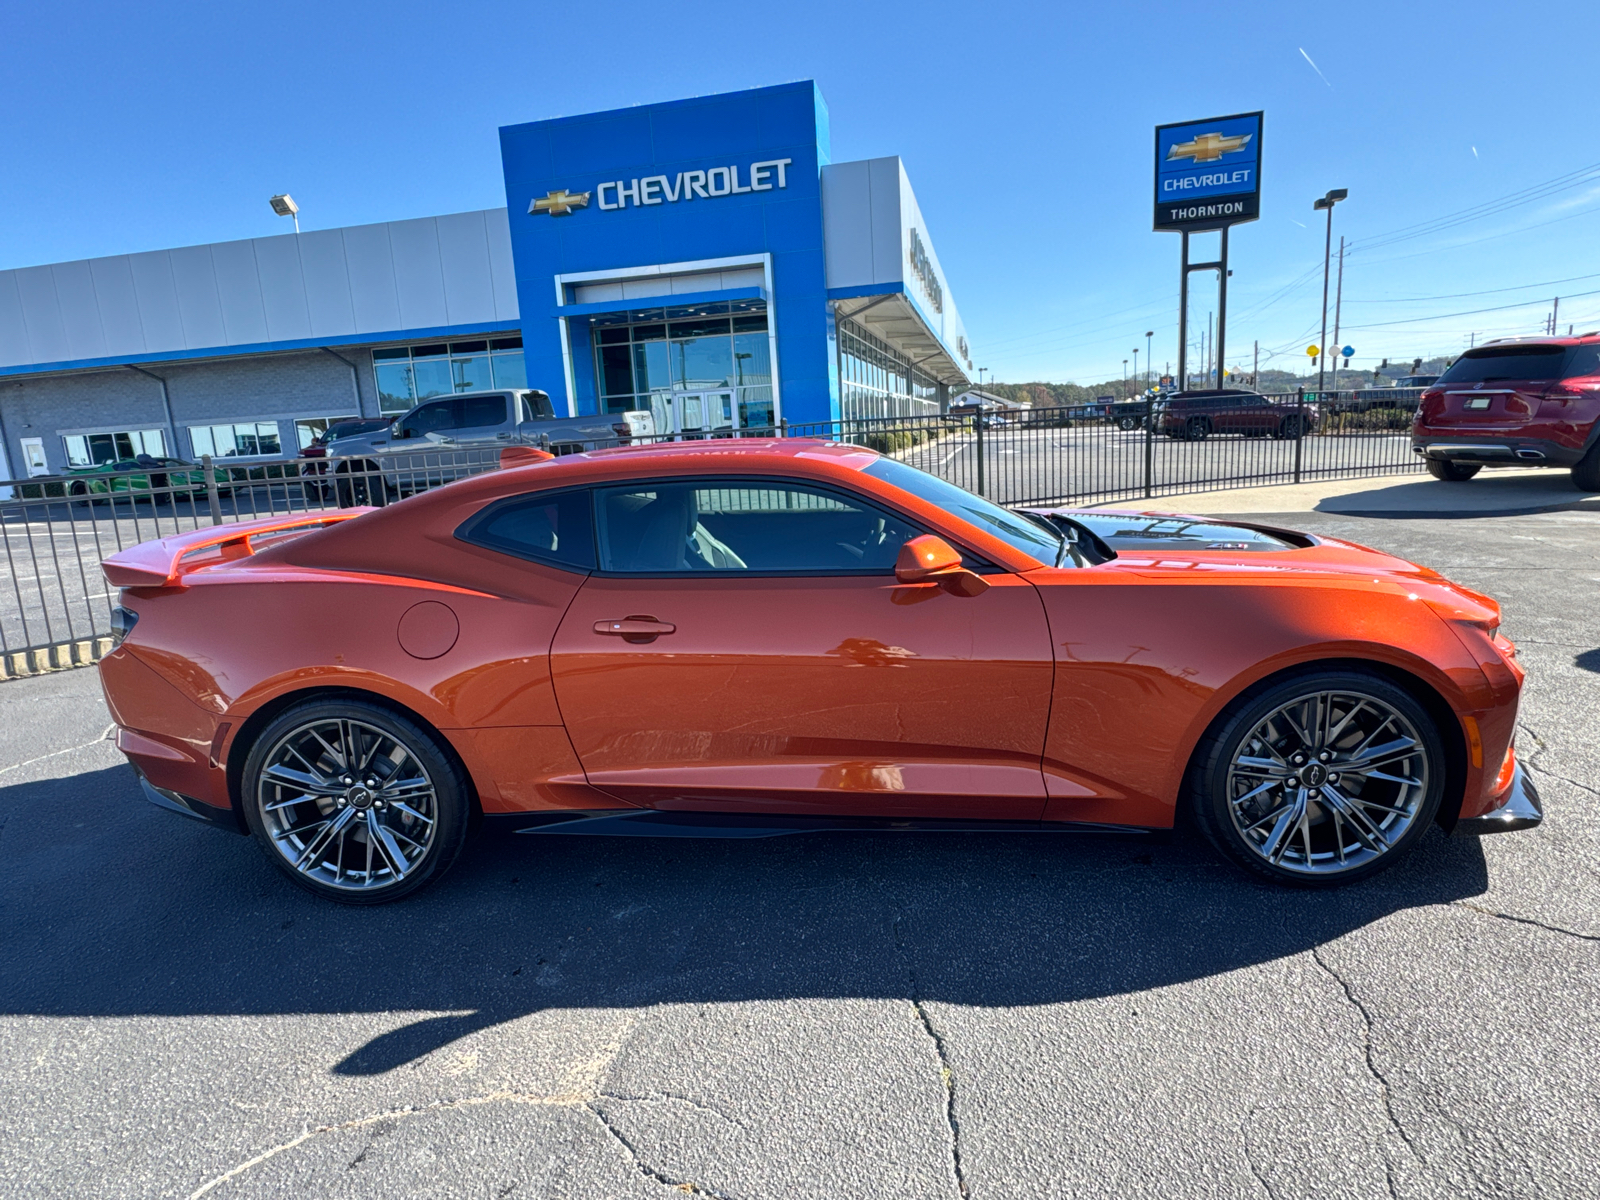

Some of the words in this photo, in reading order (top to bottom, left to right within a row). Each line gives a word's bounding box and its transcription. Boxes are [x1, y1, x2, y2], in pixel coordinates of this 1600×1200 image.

[597, 158, 792, 210] CHEVROLET
[1163, 169, 1251, 191] CHEVROLET
[1170, 202, 1243, 220] THORNTON
